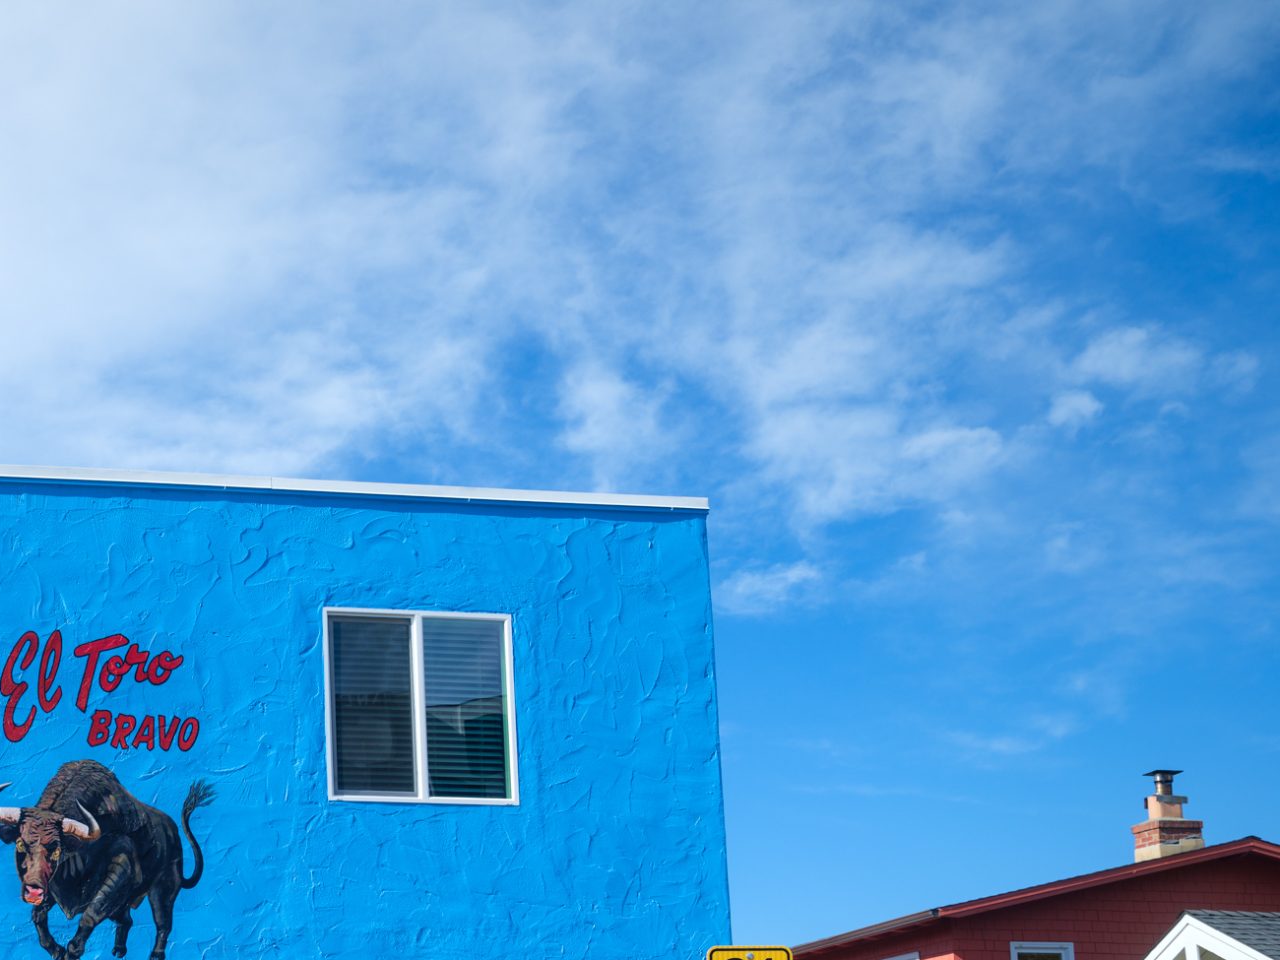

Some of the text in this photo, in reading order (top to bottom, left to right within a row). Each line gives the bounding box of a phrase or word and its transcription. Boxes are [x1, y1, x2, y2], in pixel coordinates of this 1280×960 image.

[0, 629, 184, 742] El Toro
[87, 709, 200, 751] BRAVO
